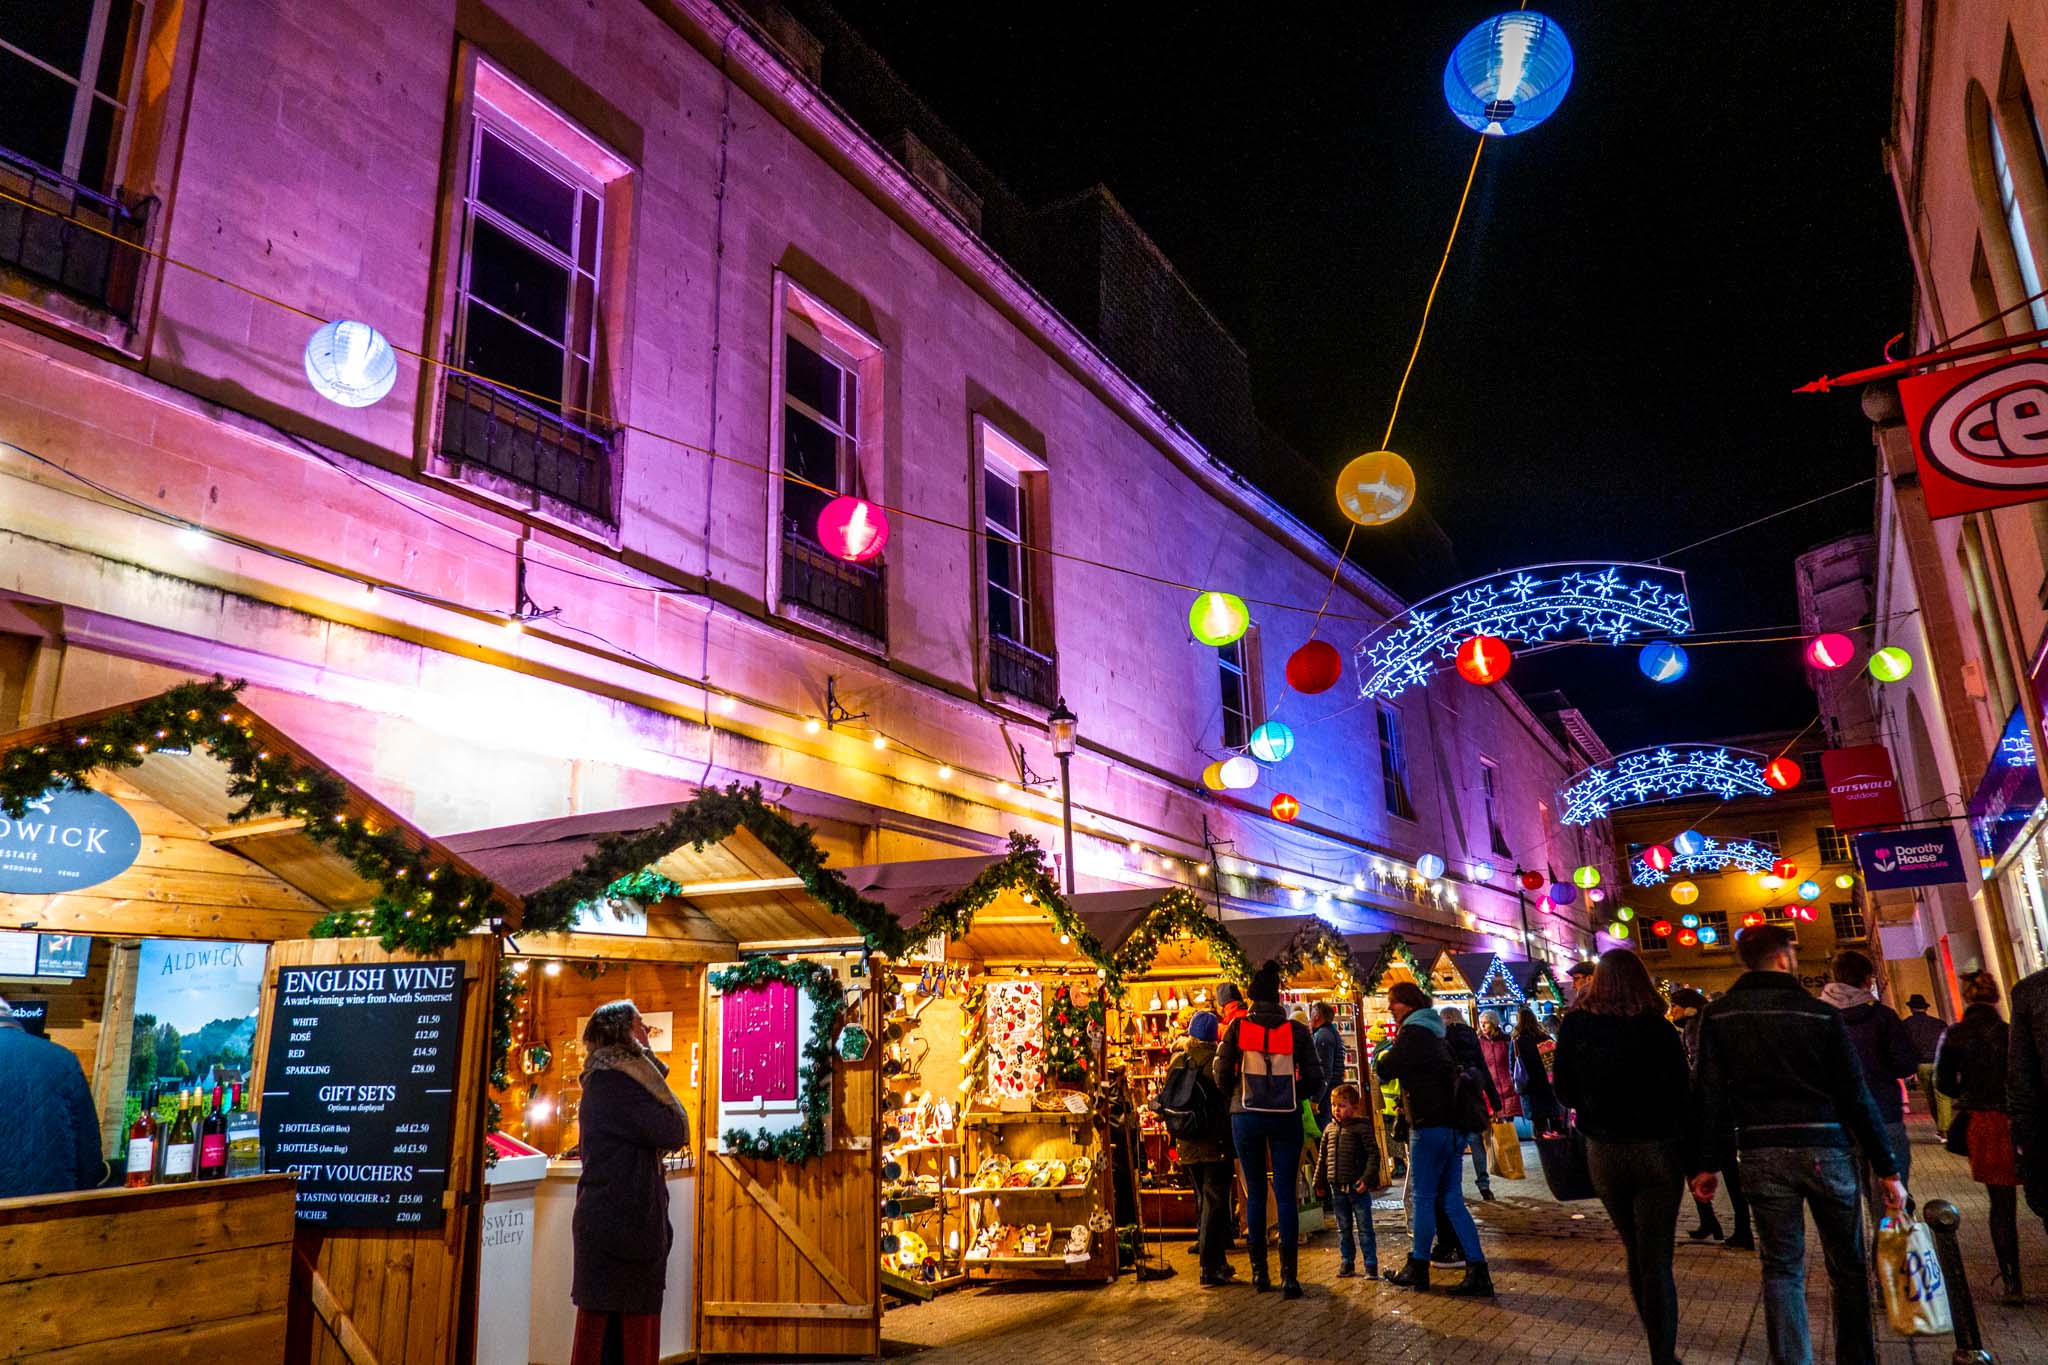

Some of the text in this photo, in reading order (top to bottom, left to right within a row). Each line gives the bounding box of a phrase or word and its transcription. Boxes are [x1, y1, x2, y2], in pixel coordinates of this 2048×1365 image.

[1829, 780, 1892, 794] COTSWOLD
[1846, 791, 1879, 800] outdoor
[1895, 843, 1944, 856] Dorothy
[1896, 853, 1937, 865] House
[160, 944, 246, 976] ALDWICK
[284, 967, 457, 993] ENGLISH WINE
[283, 992, 453, 1007] Award-winning wine from North Somerset
[12, 1007, 44, 1018] about
[292, 1015, 441, 1027] WHITE £11.50
[290, 1030, 439, 1042] ROSÉ £12.00
[288, 1047, 437, 1059] RED £14.50
[285, 1064, 436, 1075] SPARKLING £28.00
[319, 1084, 396, 1101] GIFT SETS
[327, 1103, 349, 1113] Options
[357, 1103, 385, 1113] displayed
[278, 1123, 430, 1134] 2 BOTTLES (Gift Box) add £2.50
[276, 1144, 282, 1153] 3
[282, 1143, 318, 1153] BOTTLES
[333, 1144, 348, 1154] Bag)
[393, 1143, 407, 1153] add
[407, 1143, 428, 1153] £3.50
[286, 1164, 414, 1182] GIFT VOUCHERS
[302, 1193, 337, 1202] TASTING
[338, 1193, 378, 1203] VOUCHER
[398, 1194, 423, 1204] £35.00
[396, 1212, 421, 1222] £20.00
